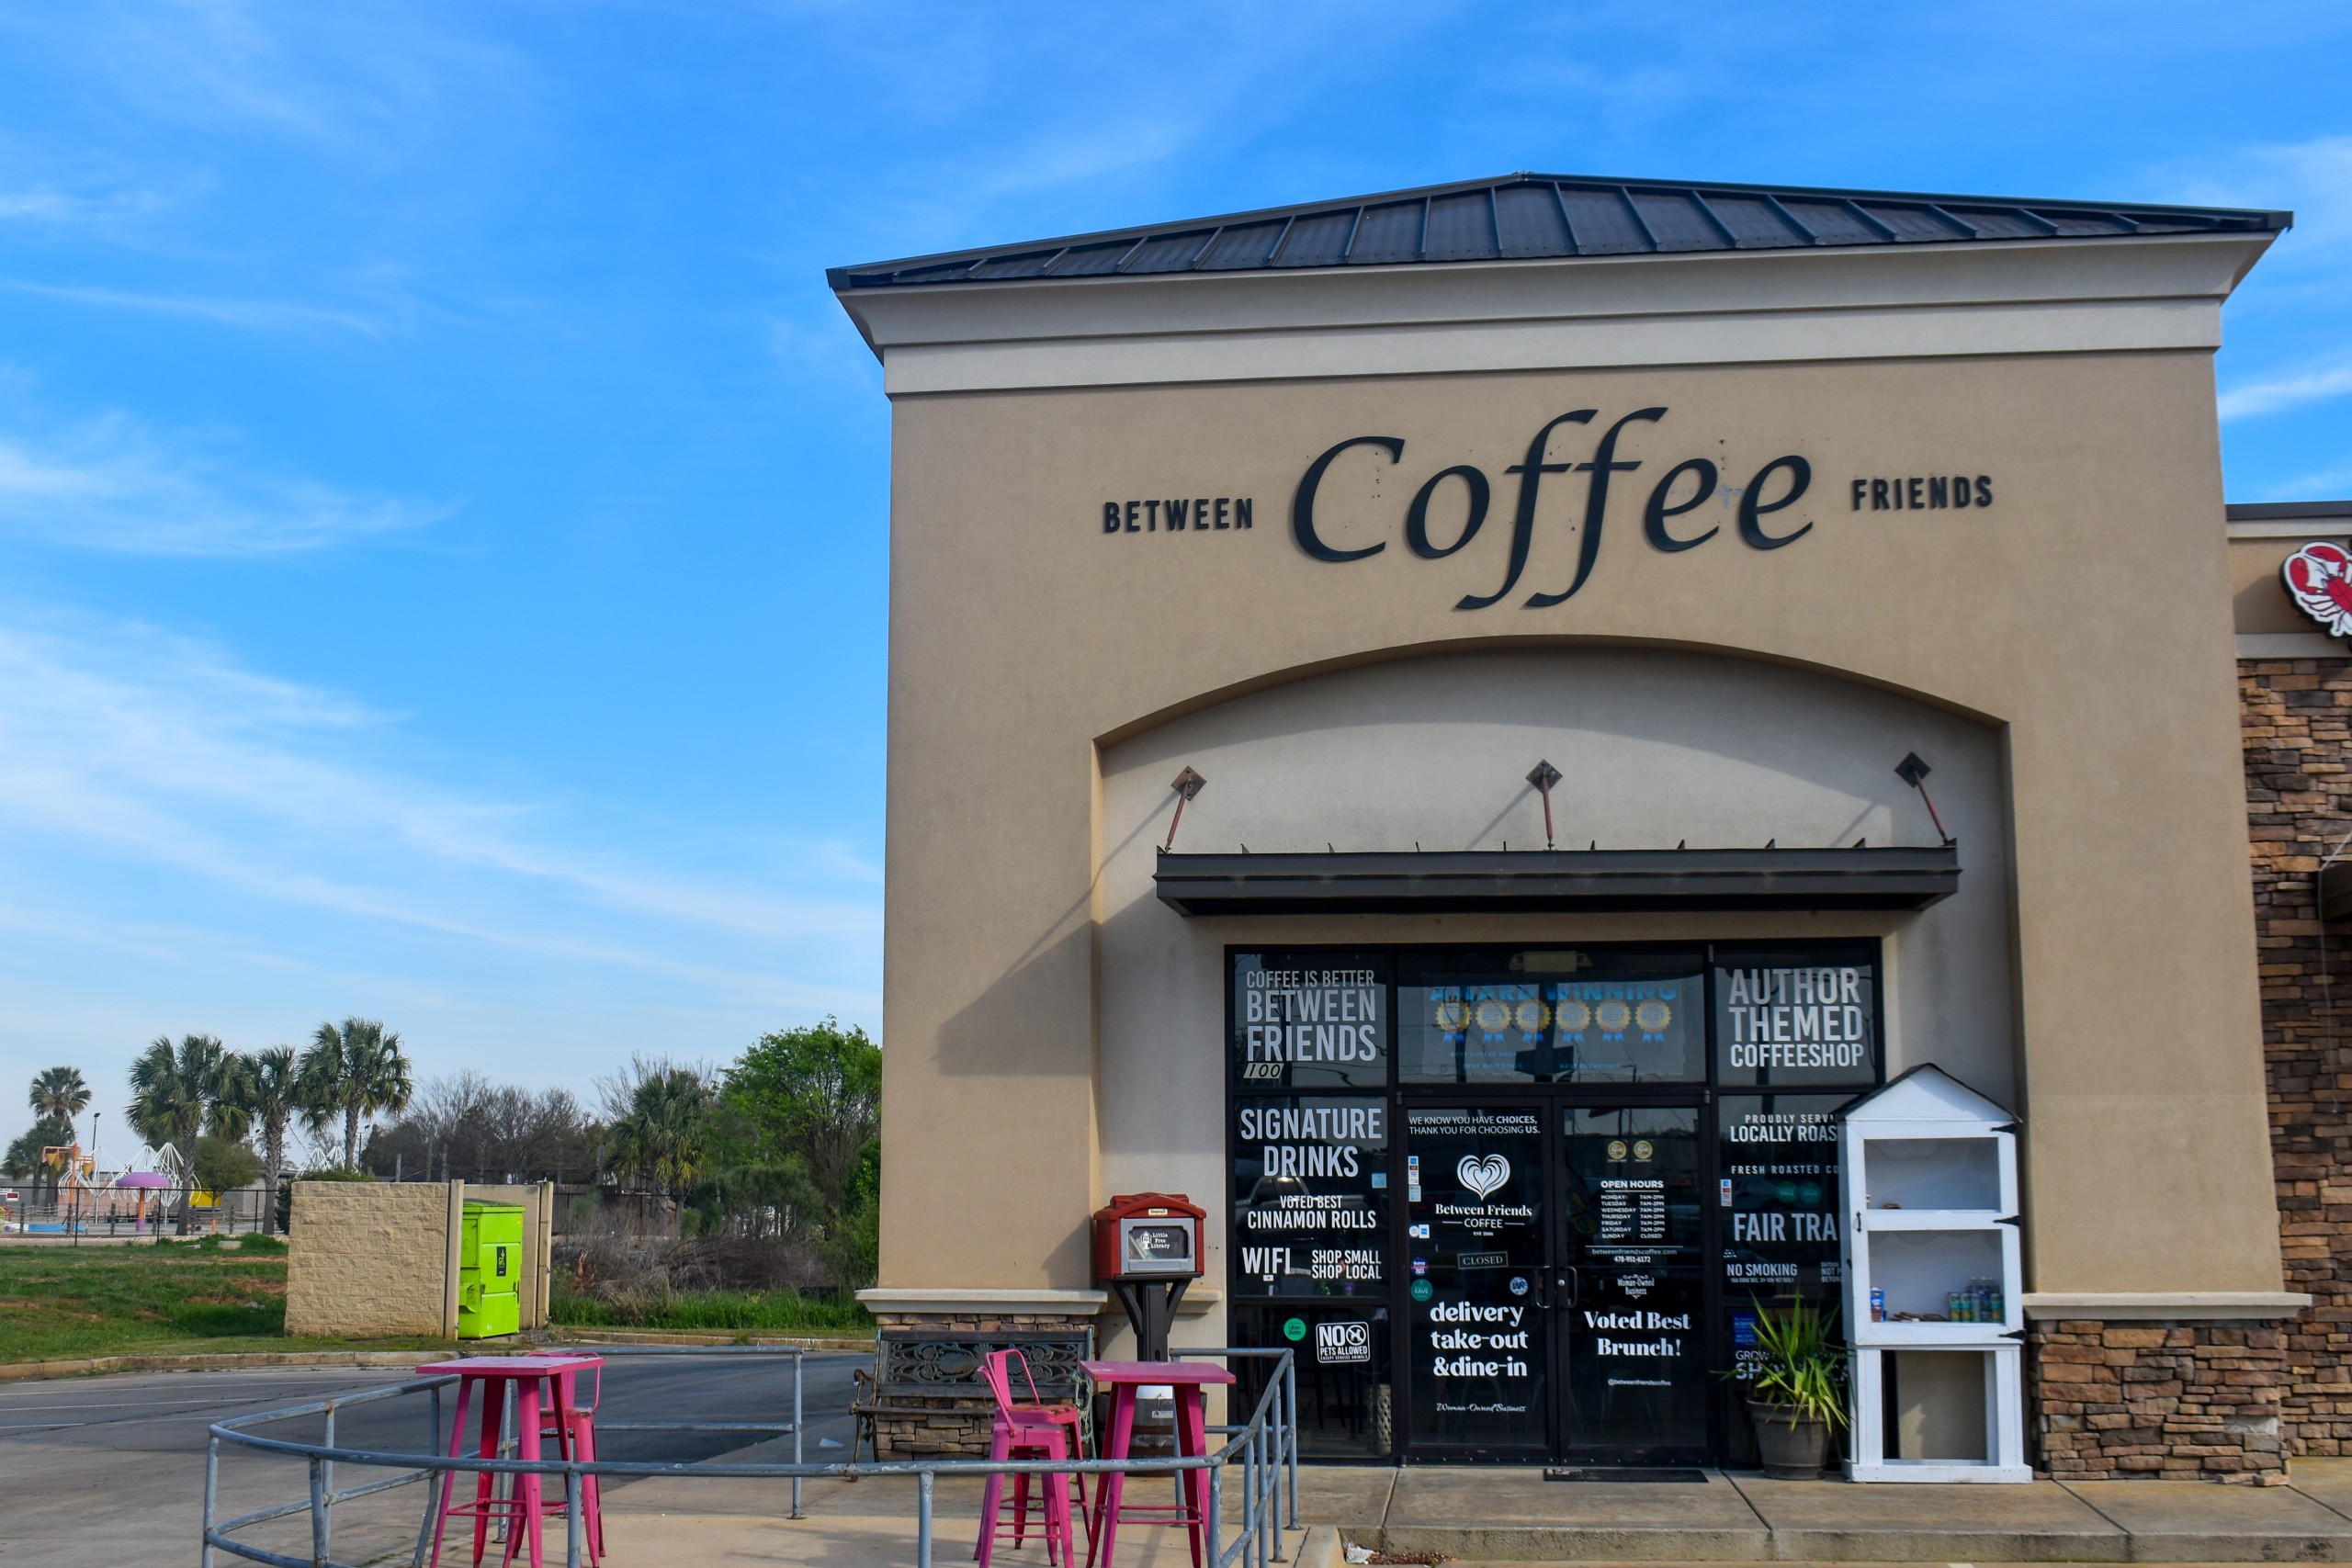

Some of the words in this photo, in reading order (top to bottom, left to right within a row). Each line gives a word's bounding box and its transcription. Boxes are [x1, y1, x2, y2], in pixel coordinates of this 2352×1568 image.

[1103, 498, 1253, 534] BETWEEN
[1291, 406, 1814, 610] Coffee
[1851, 475, 1994, 512] FRIENDS
[1247, 971, 1299, 987] COFFEE
[1305, 971, 1317, 987] IS
[1323, 970, 1374, 987] BETTER
[1729, 967, 1860, 1004] AUTHOR
[1247, 989, 1375, 1021] BETWEEN
[1728, 1006, 1862, 1042] THEMED
[1247, 1025, 1376, 1061] FRIENDS
[1730, 1043, 1863, 1066] COFFEESHOP
[1249, 1064, 1281, 1077] 100
[1240, 1108, 1382, 1140] SIGNATURE
[1424, 1116, 1451, 1124] KNOW
[1452, 1116, 1470, 1124] YOU
[1496, 1115, 1537, 1124] CHOICES,
[1745, 1114, 1795, 1123] PROUDLY
[1409, 1126, 1439, 1134] THANK
[1440, 1126, 1458, 1134] YOU
[1525, 1125, 1541, 1134] US.
[1730, 1125, 1792, 1142] LOCALLY
[1264, 1146, 1359, 1177] DRINKS
[1732, 1166, 1765, 1174] FRESH
[1771, 1166, 1819, 1174] ROASTED
[1600, 1180, 1628, 1189] OPEN
[1630, 1180, 1664, 1189] HOURS
[1280, 1196, 1313, 1208] VOTED
[1317, 1196, 1342, 1208] BEST
[1435, 1203, 1484, 1215] Between
[1487, 1204, 1532, 1216] Friends
[1248, 1211, 1326, 1228] CINNAMON
[1331, 1211, 1376, 1228] ROLLS
[1464, 1218, 1503, 1228] COFFEE
[1734, 1213, 1785, 1241] FAIR
[1242, 1247, 1290, 1274] WIFI
[1312, 1250, 1342, 1263] SHOP
[1344, 1250, 1382, 1264] SMALL
[1463, 1256, 1503, 1266] CLOSED
[1312, 1265, 1342, 1279] SHOP
[1346, 1265, 1382, 1279] LOCAL
[1727, 1264, 1743, 1276] NO
[1746, 1264, 1797, 1276] SMOKING
[1617, 1278, 1655, 1287] Woman-Owned
[1625, 1287, 1647, 1295] Business
[1430, 1301, 1524, 1327] delivery
[1584, 1311, 1643, 1329] Voted
[1646, 1312, 1691, 1329] Best
[1319, 1325, 1346, 1347] NO
[1430, 1328, 1529, 1349] take-out
[1320, 1347, 1336, 1356] PETS
[1338, 1346, 1367, 1355] ALLOWED
[1597, 1337, 1680, 1356] Brunch!
[1433, 1356, 1527, 1376] &dine-in
